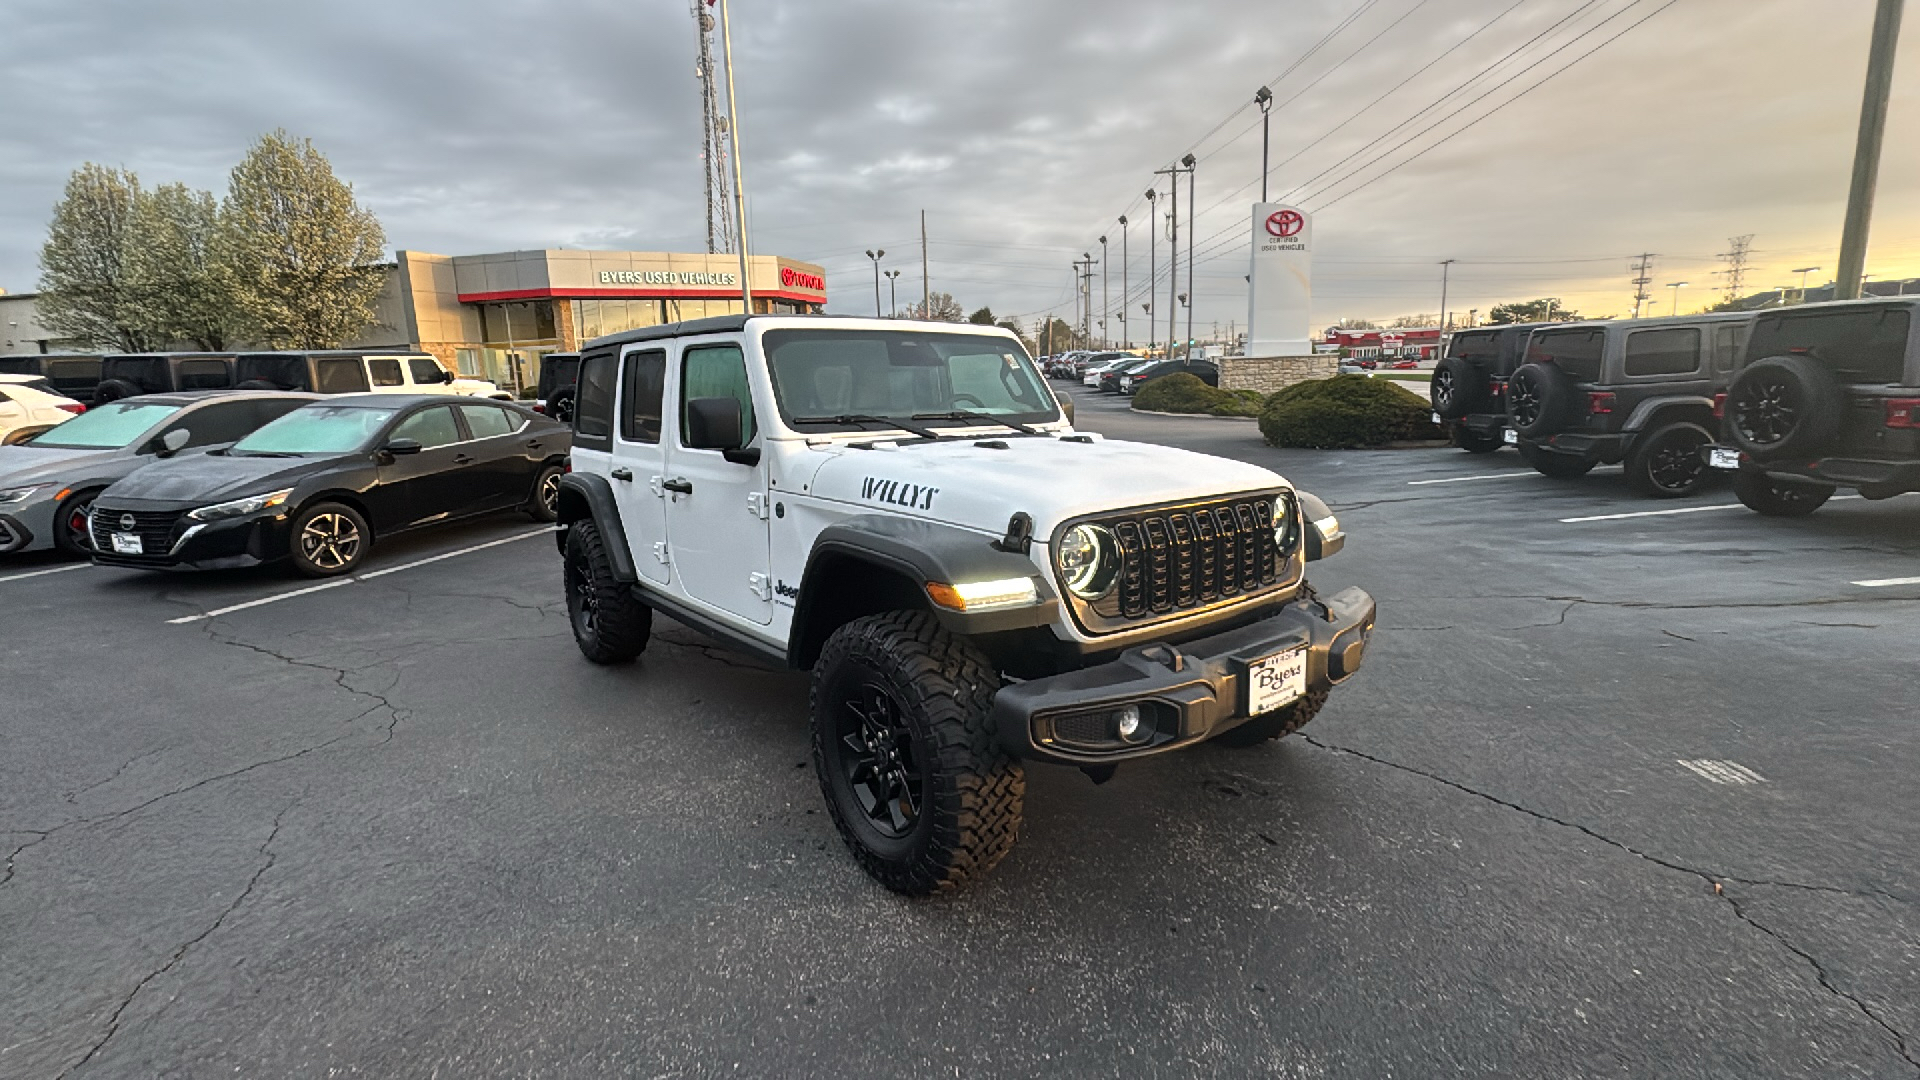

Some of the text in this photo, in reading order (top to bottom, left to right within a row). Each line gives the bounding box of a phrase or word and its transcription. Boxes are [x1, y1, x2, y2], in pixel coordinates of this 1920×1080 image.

[1269, 236, 1299, 244] CERTIFIED
[1278, 243, 1305, 251] VEHICLES
[600, 271, 737, 285] BYERS USED VEHICLES
[794, 271, 825, 290] TOYOTA
[861, 476, 940, 510] WILLYS
[1253, 665, 1301, 690] Byers
